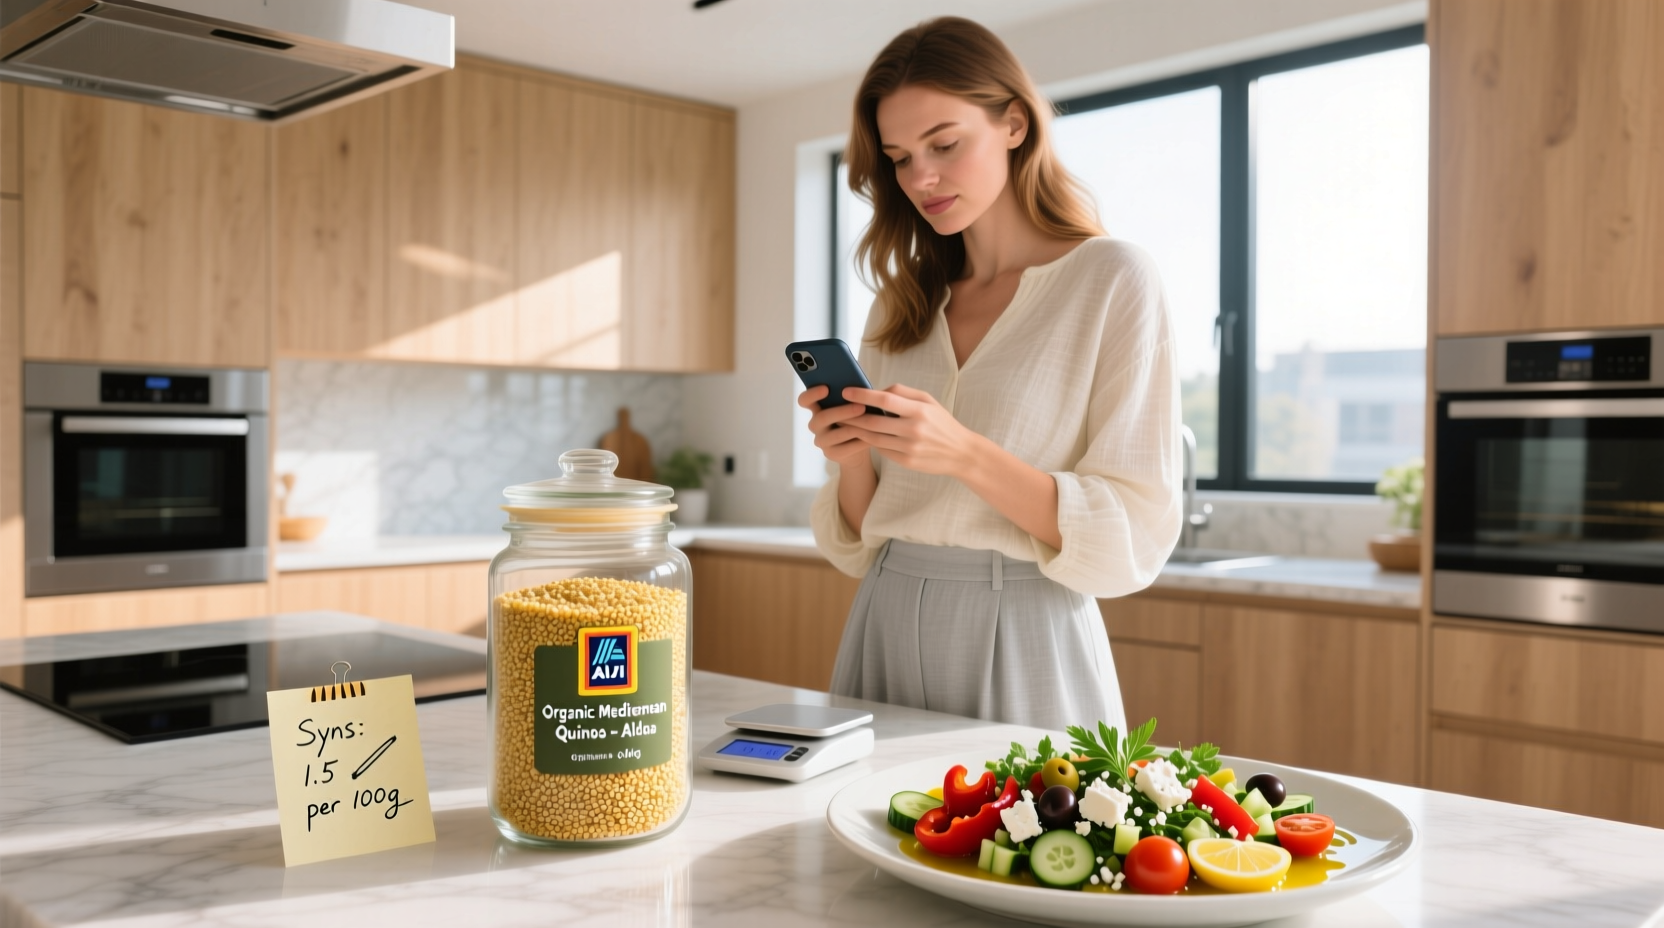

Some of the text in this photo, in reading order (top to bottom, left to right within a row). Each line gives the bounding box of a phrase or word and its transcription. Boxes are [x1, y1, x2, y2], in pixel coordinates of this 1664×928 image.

[542, 704, 595, 723] Organic
[296, 718, 364, 758] Syns:
[304, 759, 339, 787] 1.5
[307, 787, 414, 832] per 100g
